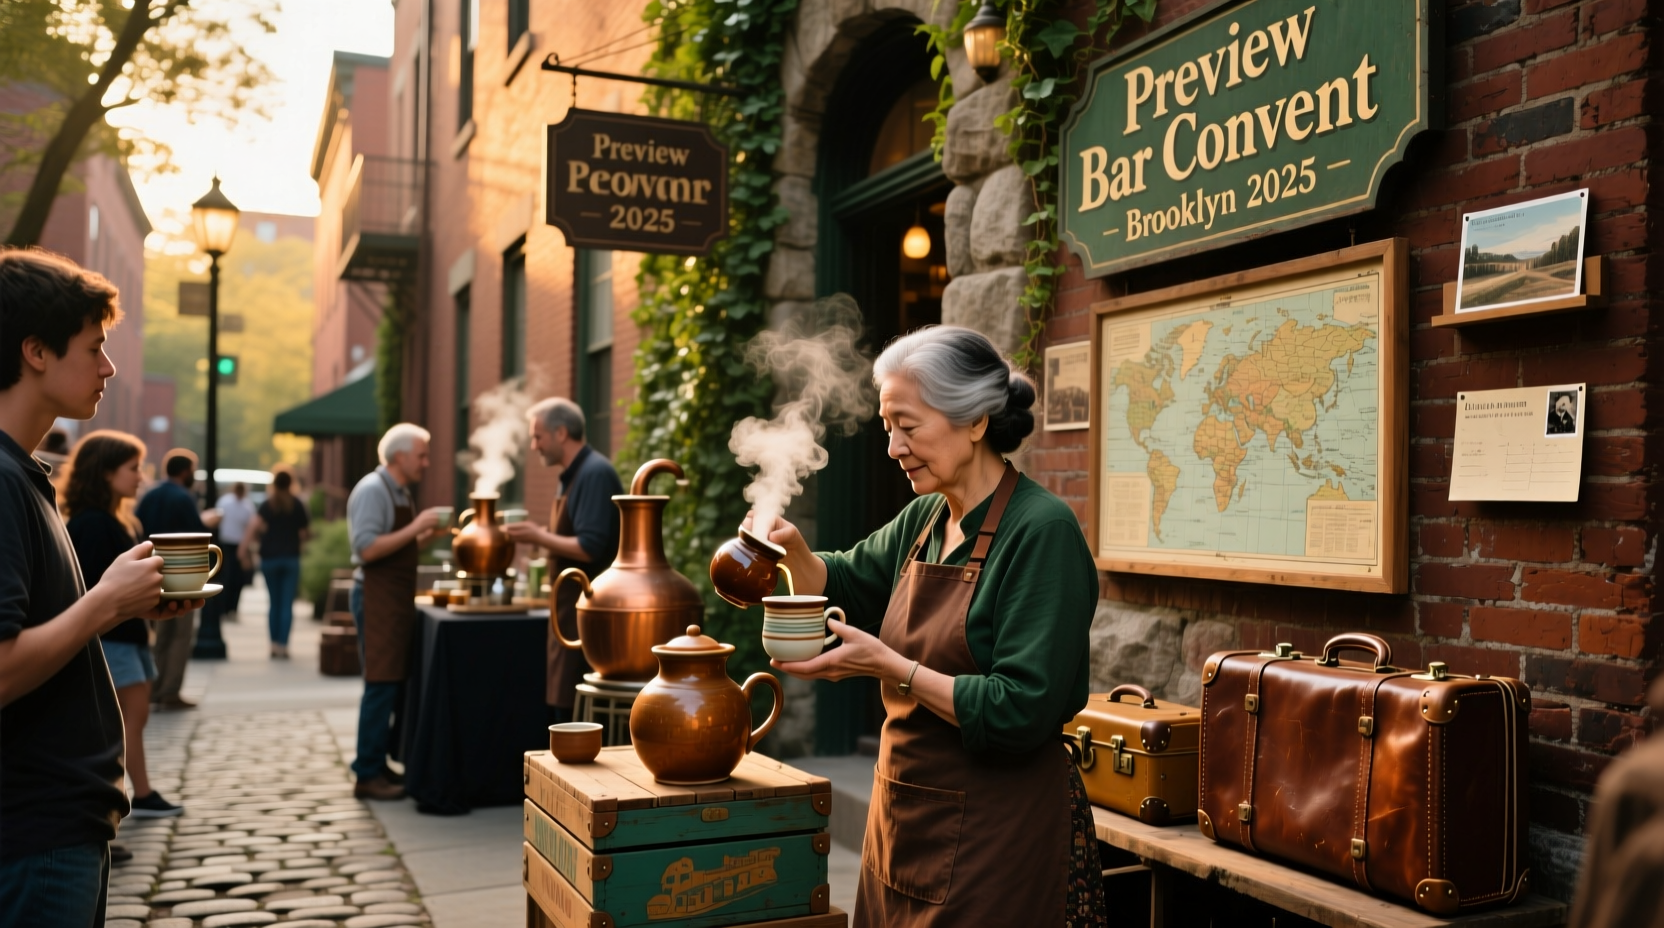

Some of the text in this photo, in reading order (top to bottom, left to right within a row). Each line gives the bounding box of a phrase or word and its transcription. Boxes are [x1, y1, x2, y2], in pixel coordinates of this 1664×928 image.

[1123, 6, 1316, 136] Preview
[592, 133, 690, 166] Preview
[1078, 53, 1378, 213] Bar Convent
[609, 204, 675, 233] 2025
[1126, 156, 1316, 242] Brooklyn 2025
